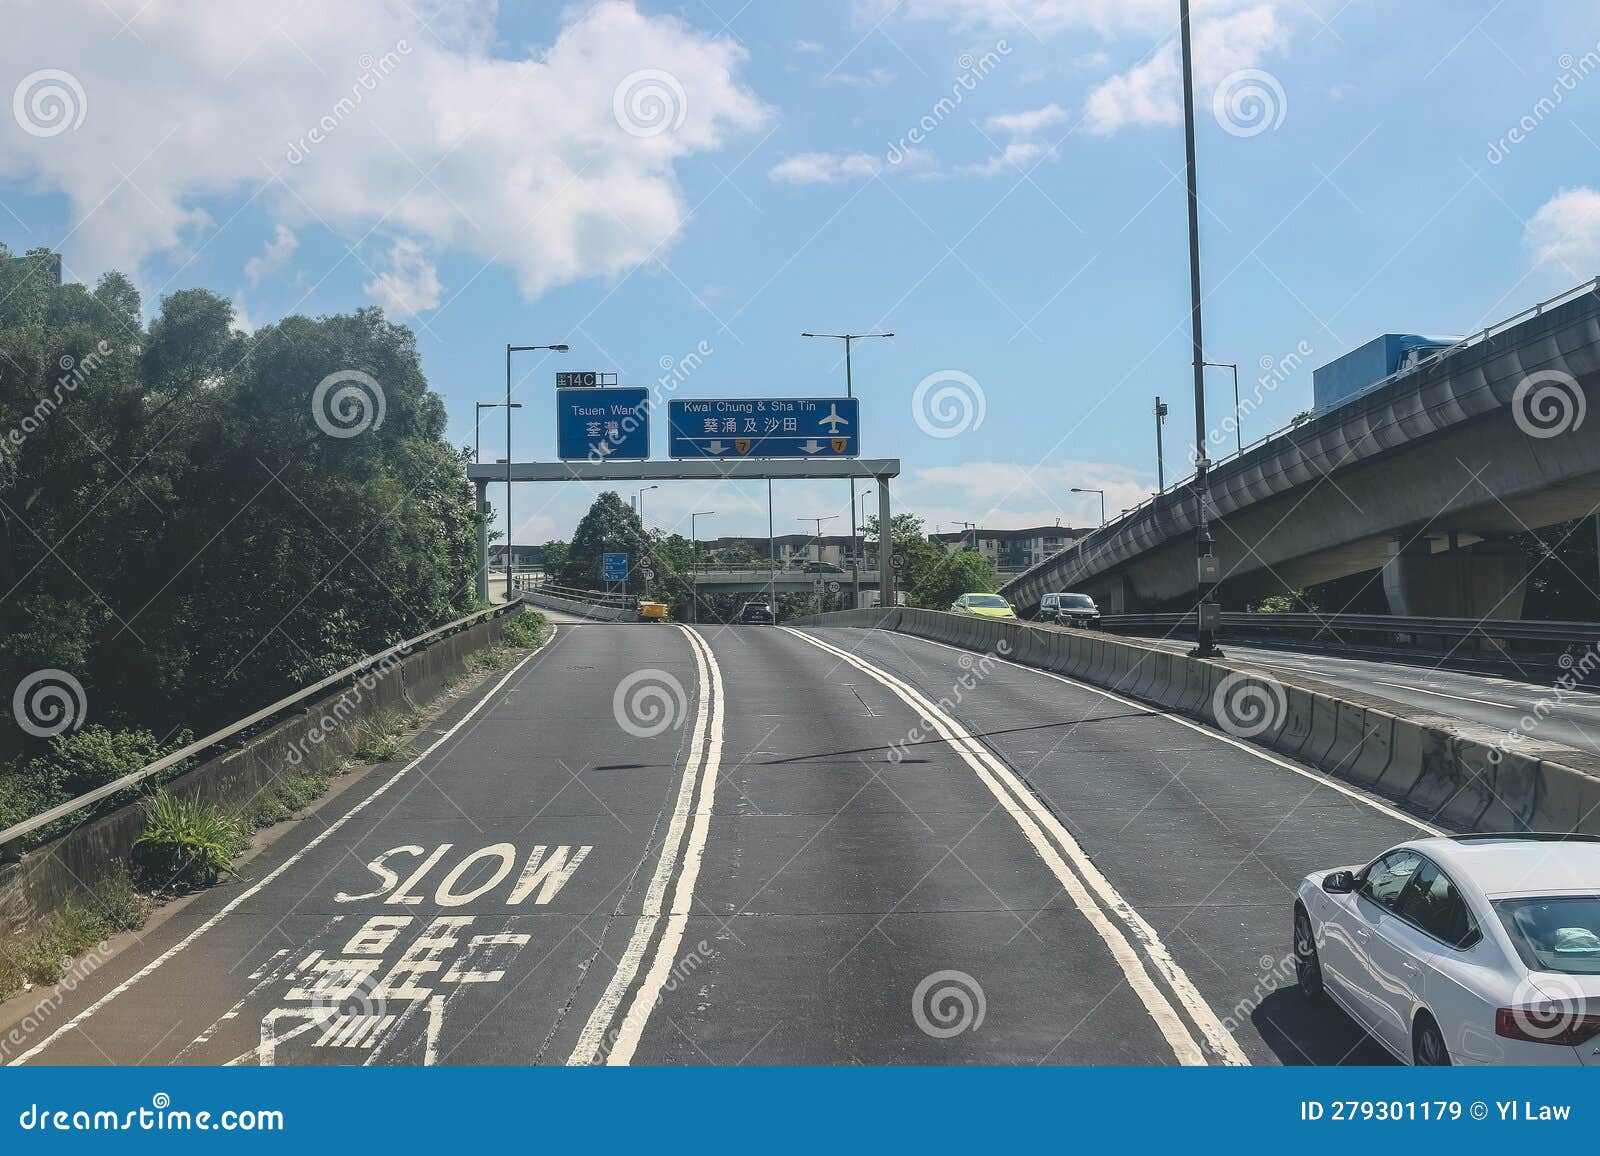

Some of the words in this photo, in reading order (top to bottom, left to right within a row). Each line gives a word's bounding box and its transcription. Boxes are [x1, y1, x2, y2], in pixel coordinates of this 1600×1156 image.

[571, 405, 605, 416] Tsuen
[610, 405, 635, 415] Wan
[684, 402, 712, 412] Kwai
[716, 402, 753, 414] Chung
[757, 402, 766, 412] &
[771, 401, 793, 411] Sha
[797, 401, 816, 411] Tin
[334, 842, 593, 907] SLOW
